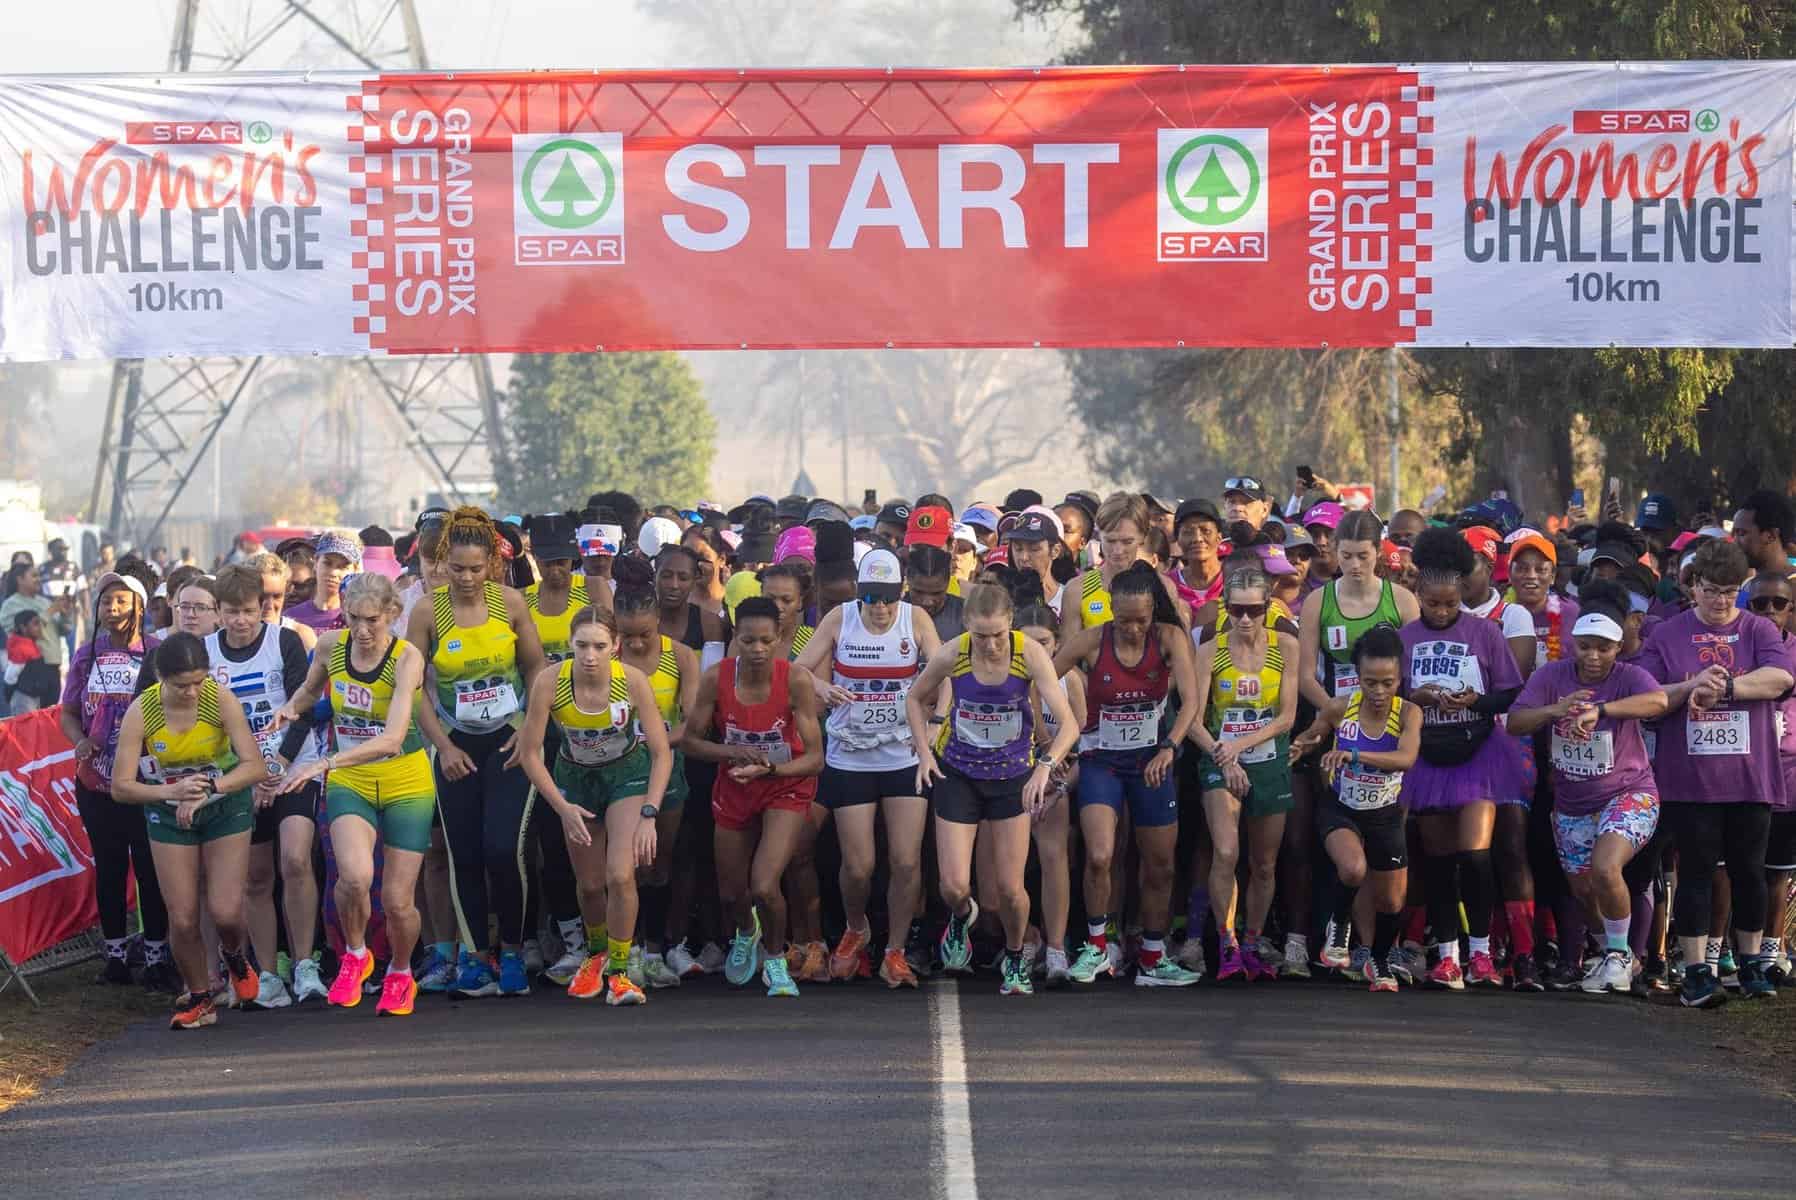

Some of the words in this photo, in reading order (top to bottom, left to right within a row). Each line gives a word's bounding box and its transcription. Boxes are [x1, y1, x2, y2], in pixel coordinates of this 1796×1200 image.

[1600, 112, 1688, 130] SPAR
[152, 124, 241, 142] SPAR
[1308, 101, 1338, 178] PRIX
[443, 107, 474, 228] GRAND
[661, 143, 1120, 252] START
[1341, 101, 1391, 312] SERIES
[390, 108, 443, 318] SERIES
[1464, 198, 1762, 264] CHALLENGE
[25, 205, 323, 276] CHALLENGE
[521, 238, 619, 259] SPAR
[1164, 235, 1262, 255] SPAR
[1307, 188, 1337, 312] GRAND
[446, 239, 477, 317] PRIX
[1566, 272, 1660, 302] 10km
[128, 281, 223, 312] 10km
[95, 670, 131, 686] 3593
[466, 690, 497, 701] SPAR
[1115, 691, 1147, 699] XCEL
[1238, 679, 1258, 697] 50
[480, 706, 490, 720] 4
[614, 708, 626, 726] J
[863, 708, 898, 724] 253
[968, 712, 1001, 721] SPAR
[1111, 713, 1144, 721] SPAR
[1698, 713, 1729, 721] SPAR
[982, 727, 989, 740] 1
[1120, 727, 1141, 742] 12
[1693, 729, 1738, 745] 2483
[1563, 744, 1595, 760] 614
